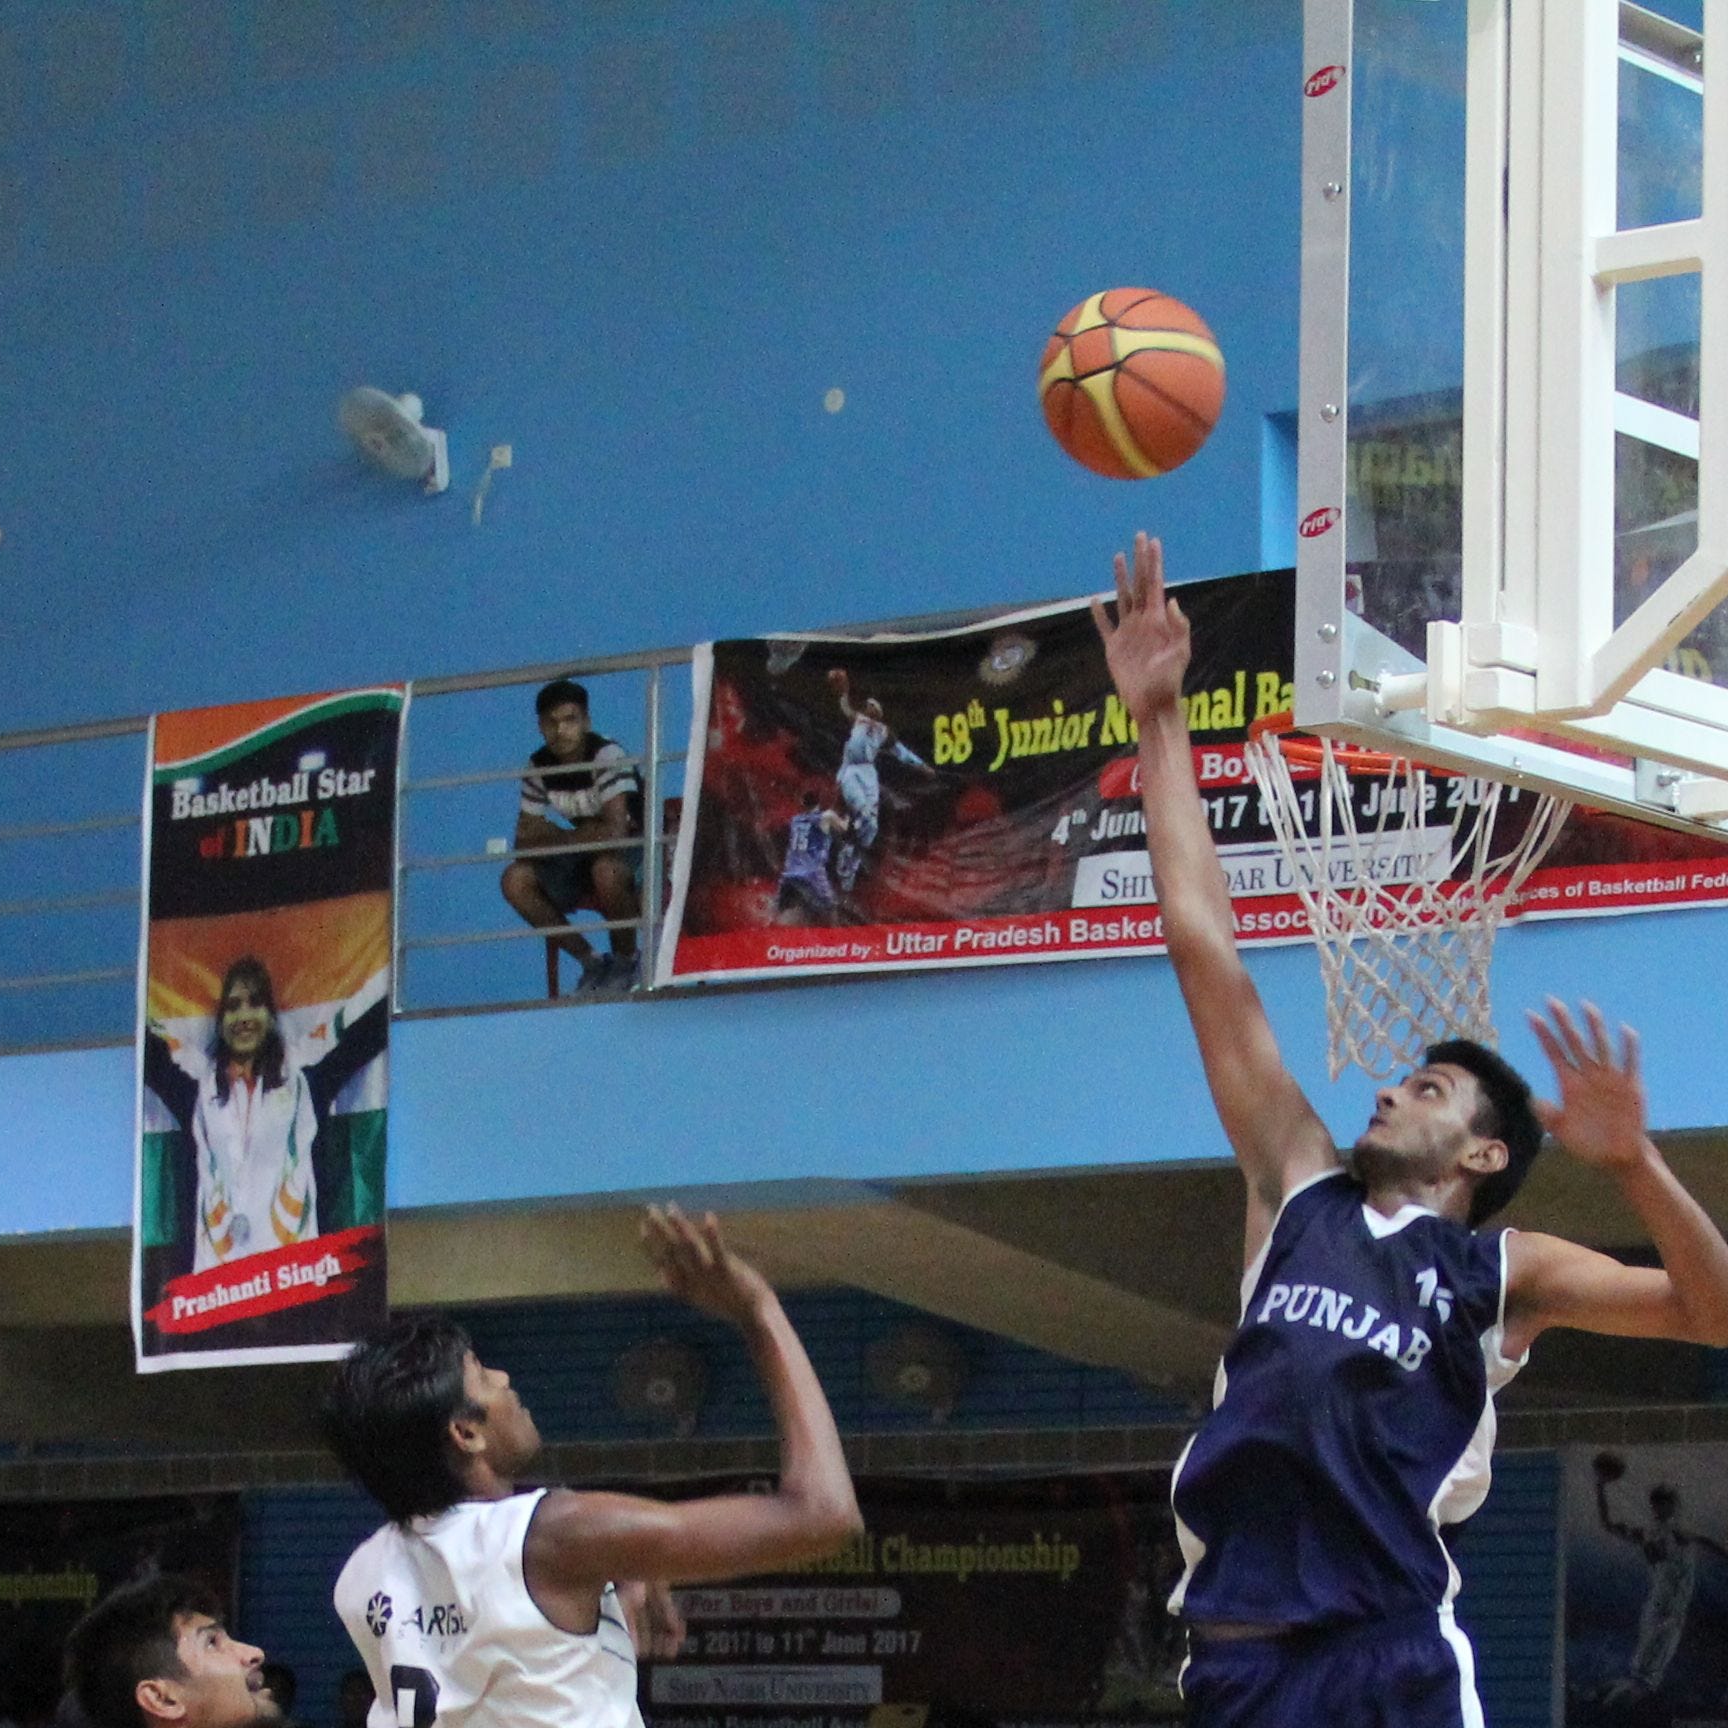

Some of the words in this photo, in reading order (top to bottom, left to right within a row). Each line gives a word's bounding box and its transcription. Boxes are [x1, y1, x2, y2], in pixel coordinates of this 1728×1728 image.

[989, 698, 1096, 773] Junior
[171, 772, 309, 822] Basketball
[318, 769, 375, 801] Star
[200, 832, 225, 858] of
[233, 808, 339, 859] INDIA
[1091, 808, 1150, 841] Jun
[1100, 867, 1155, 901] SHI
[766, 941, 845, 962] Organized
[886, 930, 947, 957] Uttar
[953, 919, 1060, 951] Pradesh
[1068, 916, 1164, 945] Basket
[1565, 880, 1584, 898] of
[1587, 872, 1687, 897] Basketball
[172, 1271, 272, 1321] Prashanti
[277, 1253, 341, 1293] Singh
[1256, 1284, 1433, 1373] PUNJAB
[881, 1531, 1081, 1584] Championship
[872, 1629, 923, 1655] 2017
